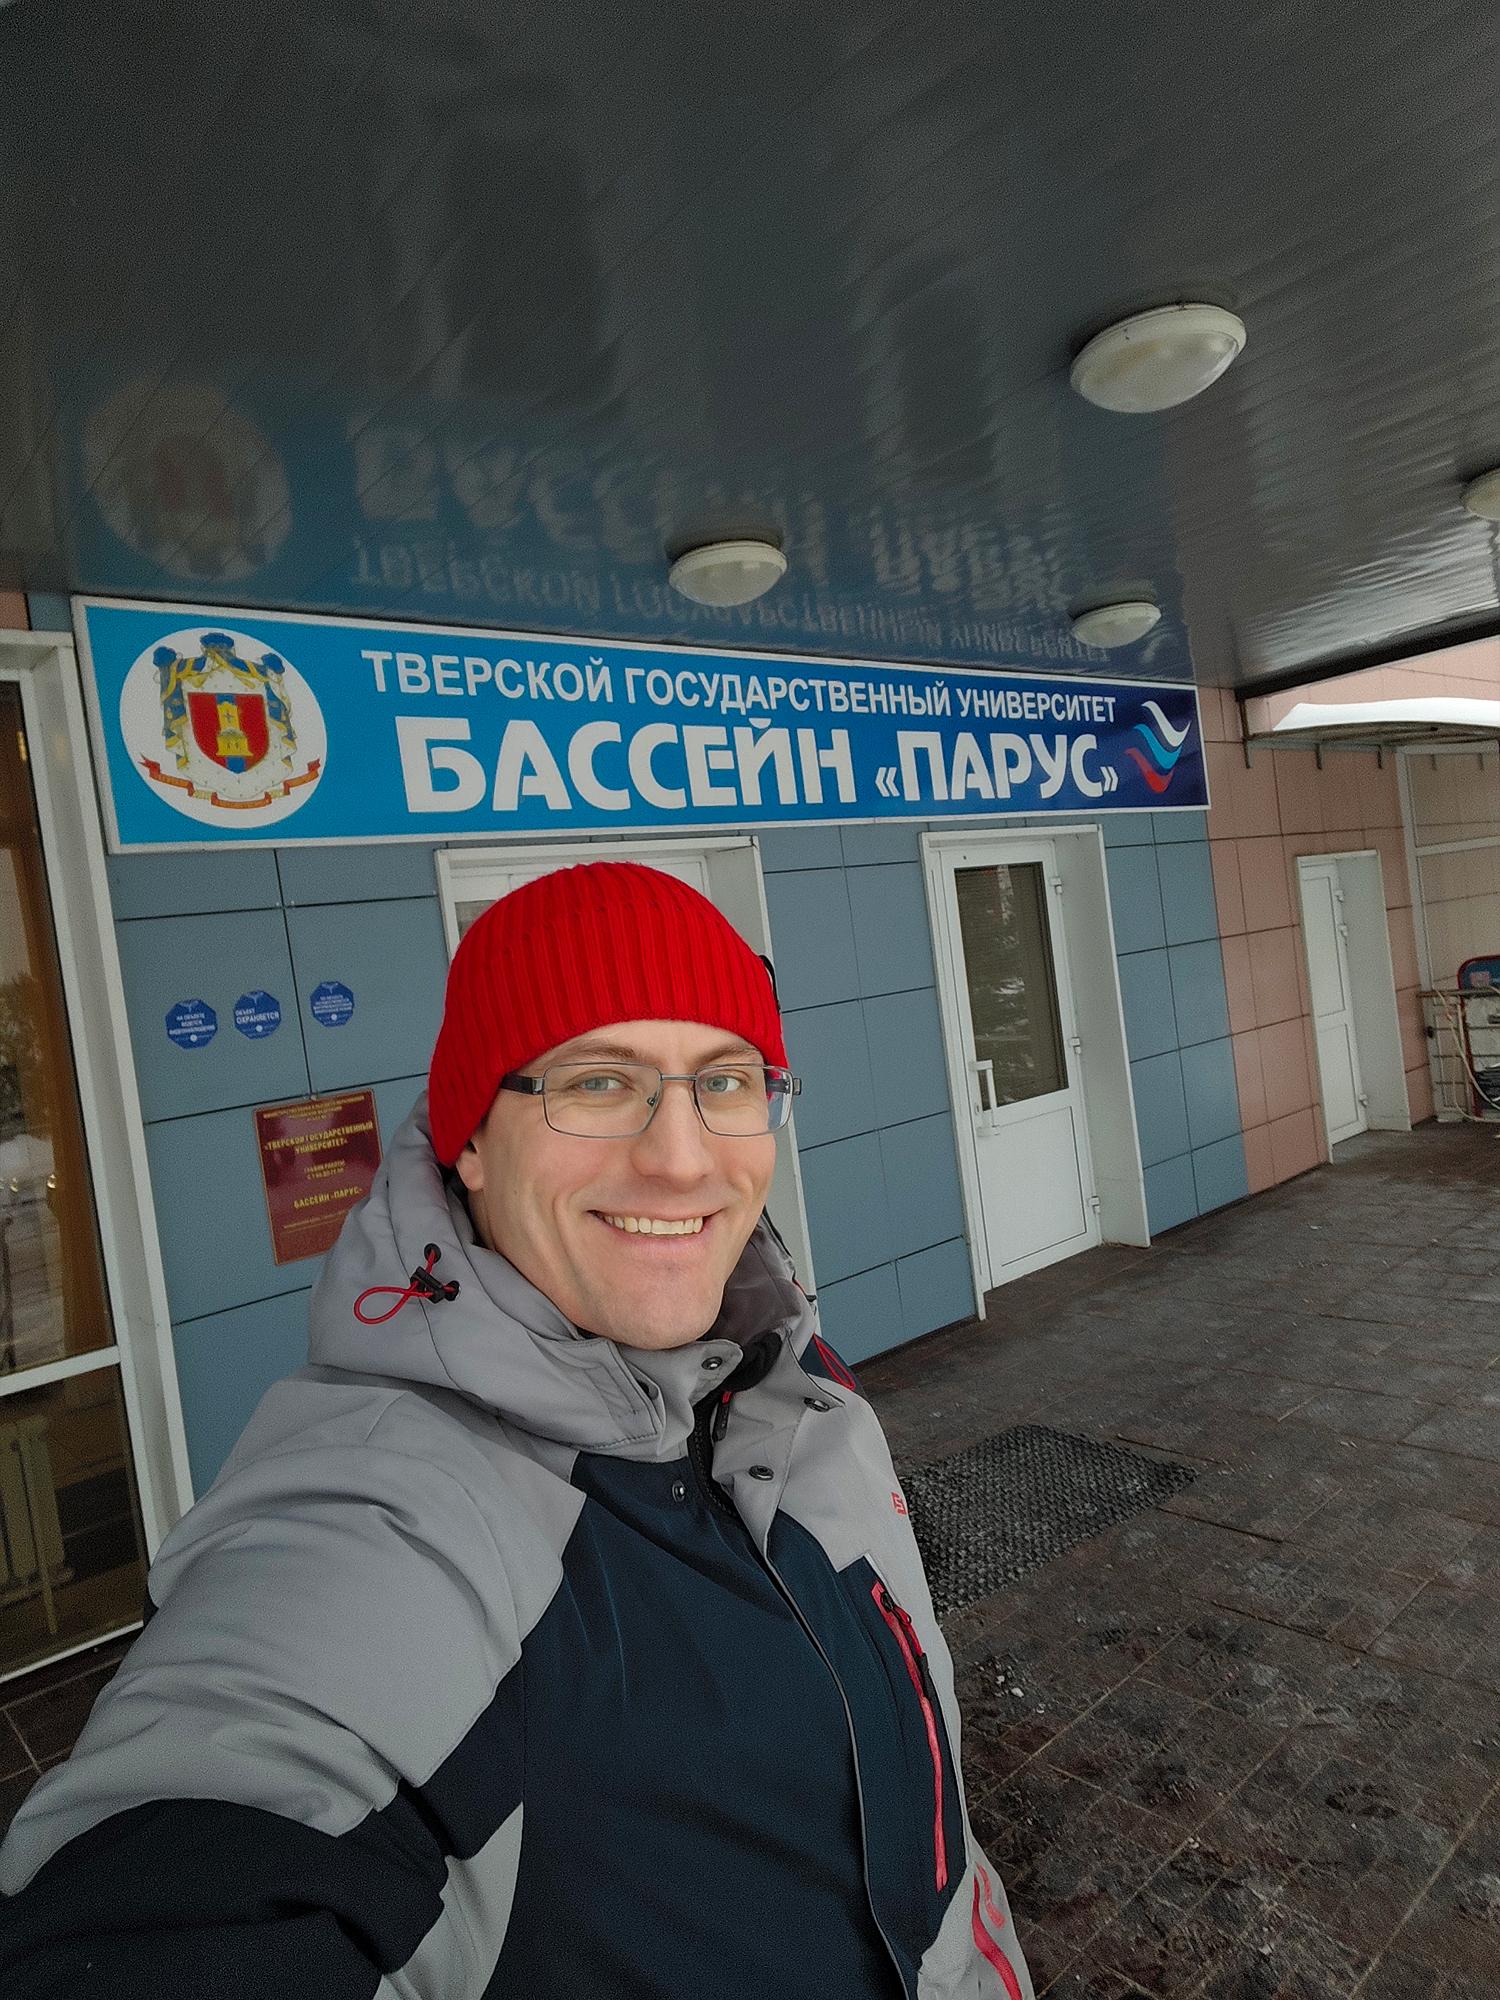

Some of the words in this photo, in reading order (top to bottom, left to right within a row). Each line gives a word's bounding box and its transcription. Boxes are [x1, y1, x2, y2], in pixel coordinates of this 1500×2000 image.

[361, 650, 613, 702] ТВЕРСКОЙ
[625, 667, 951, 717] ГОСУДАРСТВЕННЫЙ
[956, 688, 1116, 723] УНИВЕРСИТЕТ
[395, 715, 856, 813] БАССЕЙН
[875, 730, 1120, 801] «ПАРУС»
